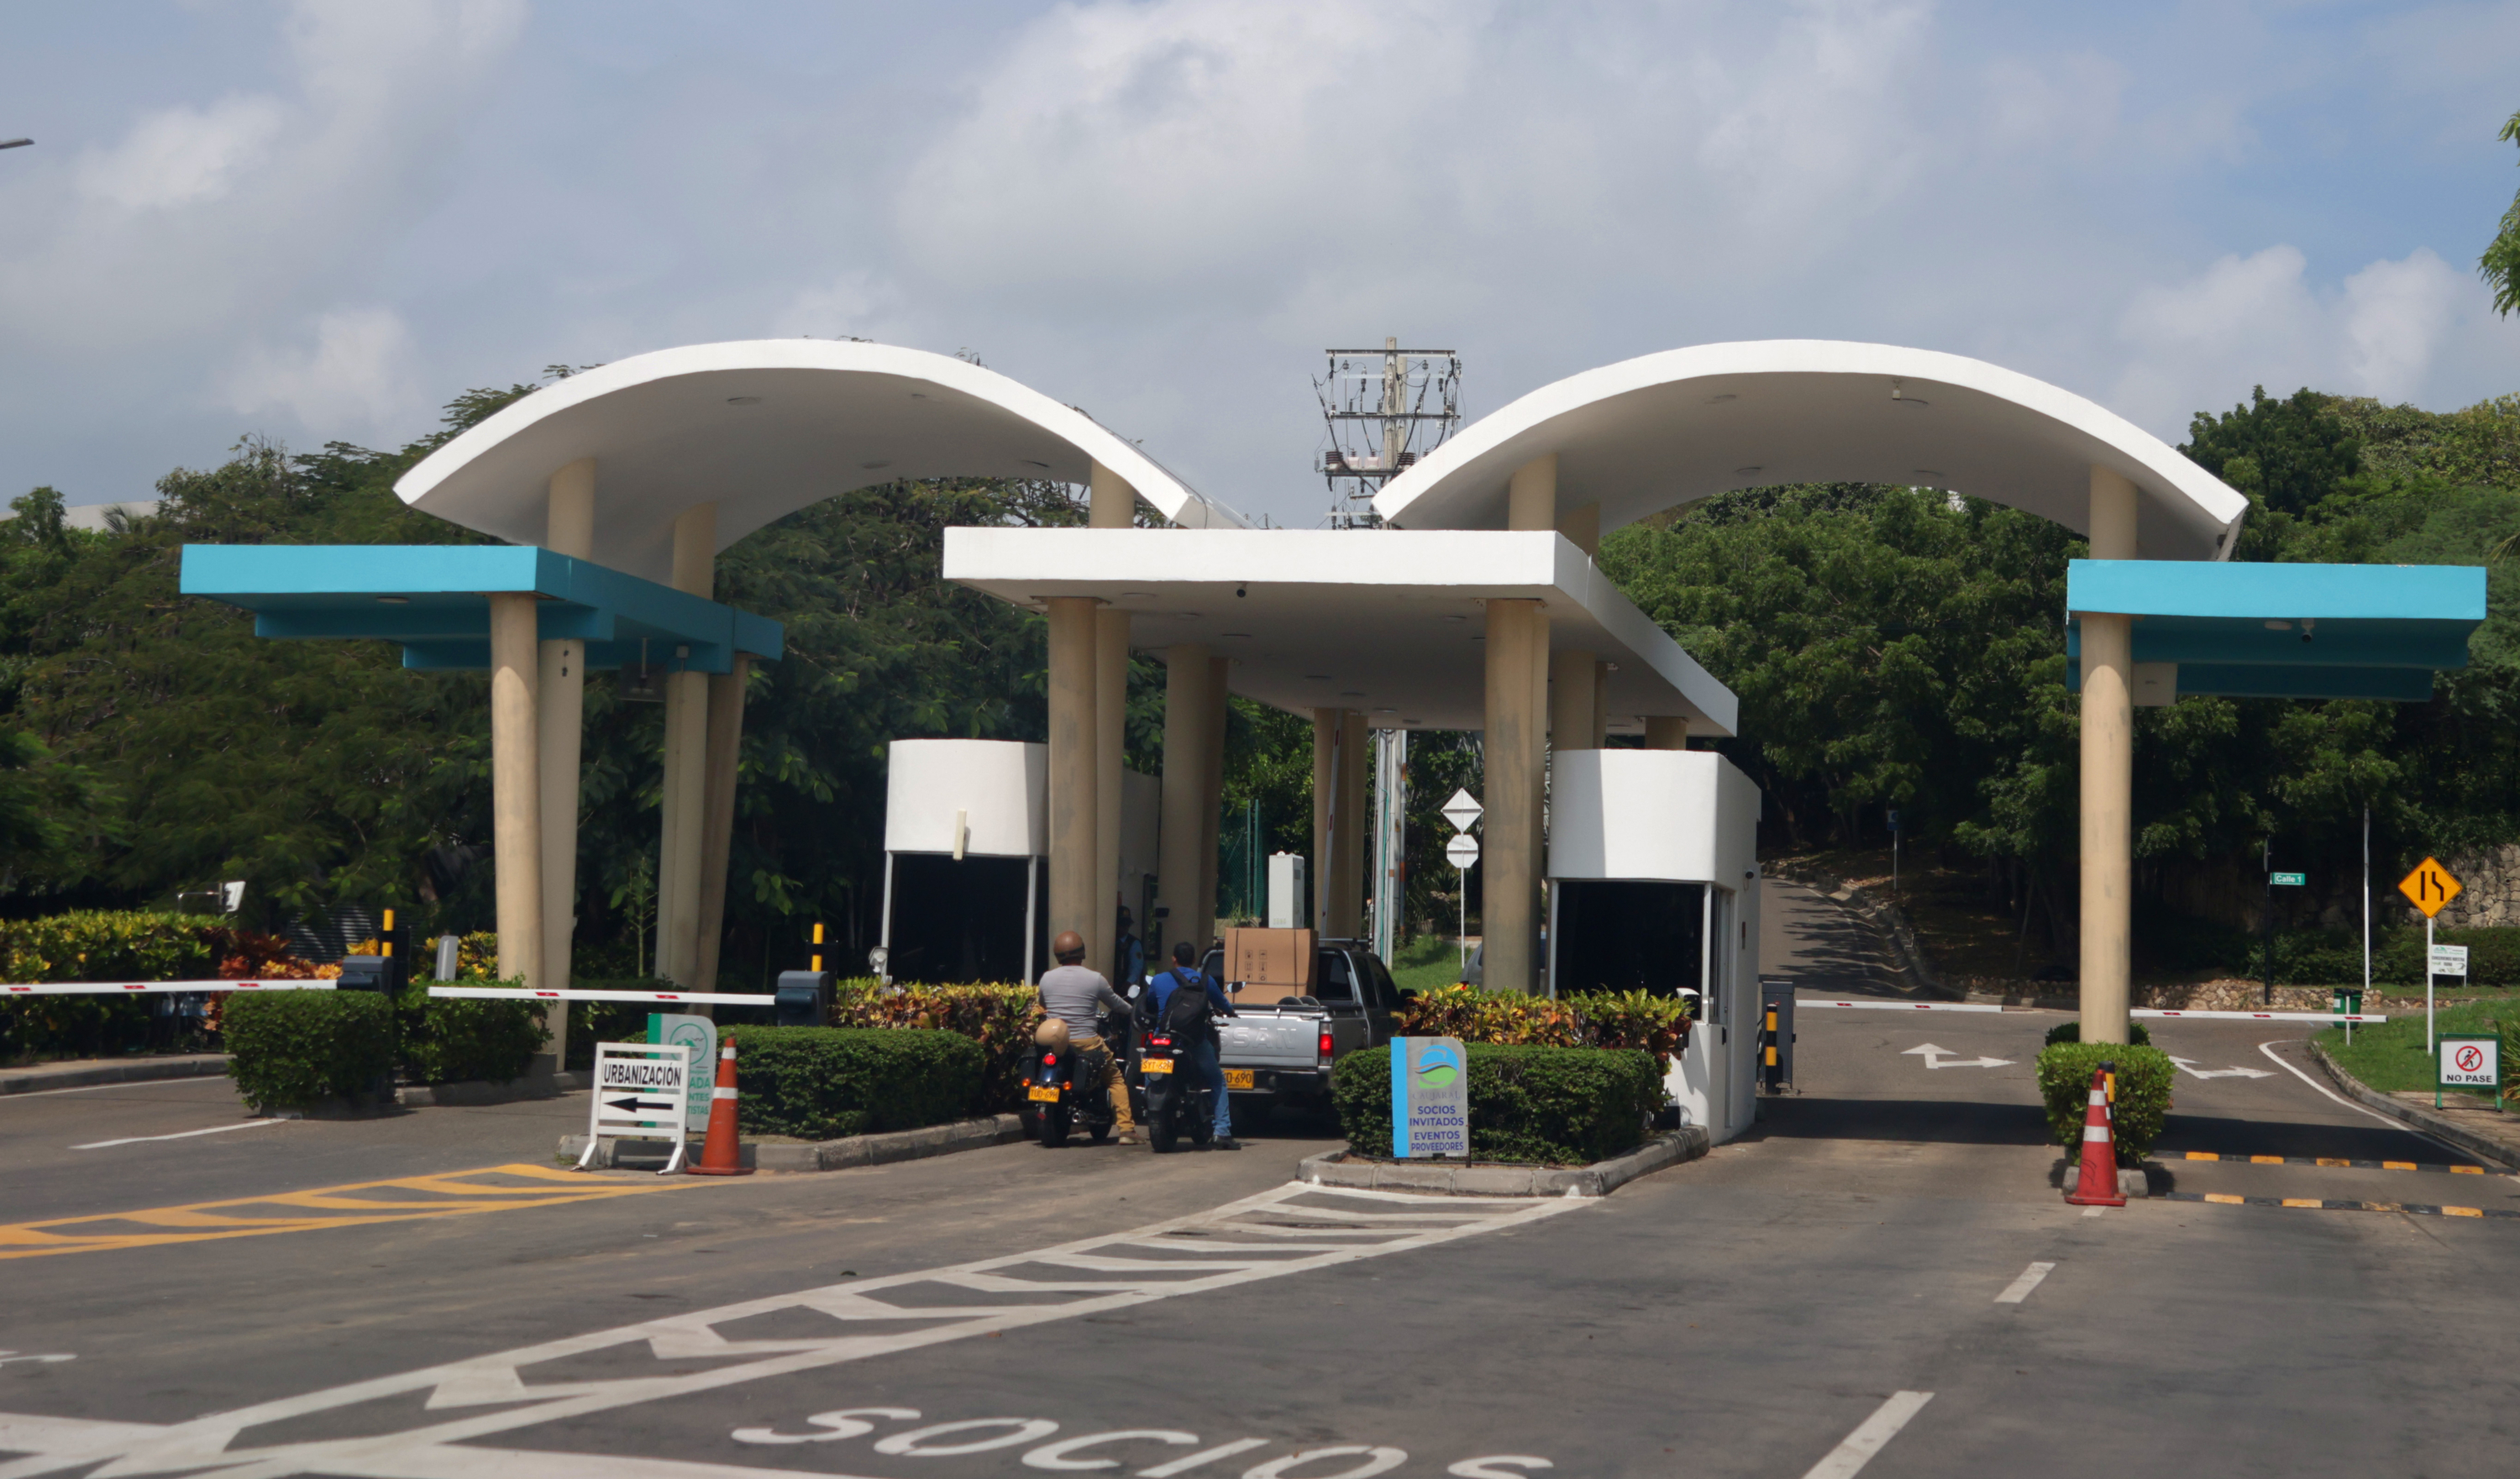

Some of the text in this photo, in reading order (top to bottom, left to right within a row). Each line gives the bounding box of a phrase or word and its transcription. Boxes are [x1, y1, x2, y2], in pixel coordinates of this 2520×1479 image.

[604, 1062, 681, 1087] URBANIZACIÓN
[1224, 1072, 1252, 1084] D-690
[2465, 1075, 2492, 1083] PASE
[689, 1077, 711, 1089] ADA
[689, 1093, 710, 1102] NTES
[1412, 1090, 1461, 1101] CAUJARAL
[687, 1105, 709, 1115] TISTAS
[1417, 1105, 1456, 1114] SOCIOS
[1410, 1117, 1464, 1126] INVITADOS
[1414, 1130, 1460, 1141] EVENTOS
[1411, 1142, 1464, 1151] PROVEEDORES
